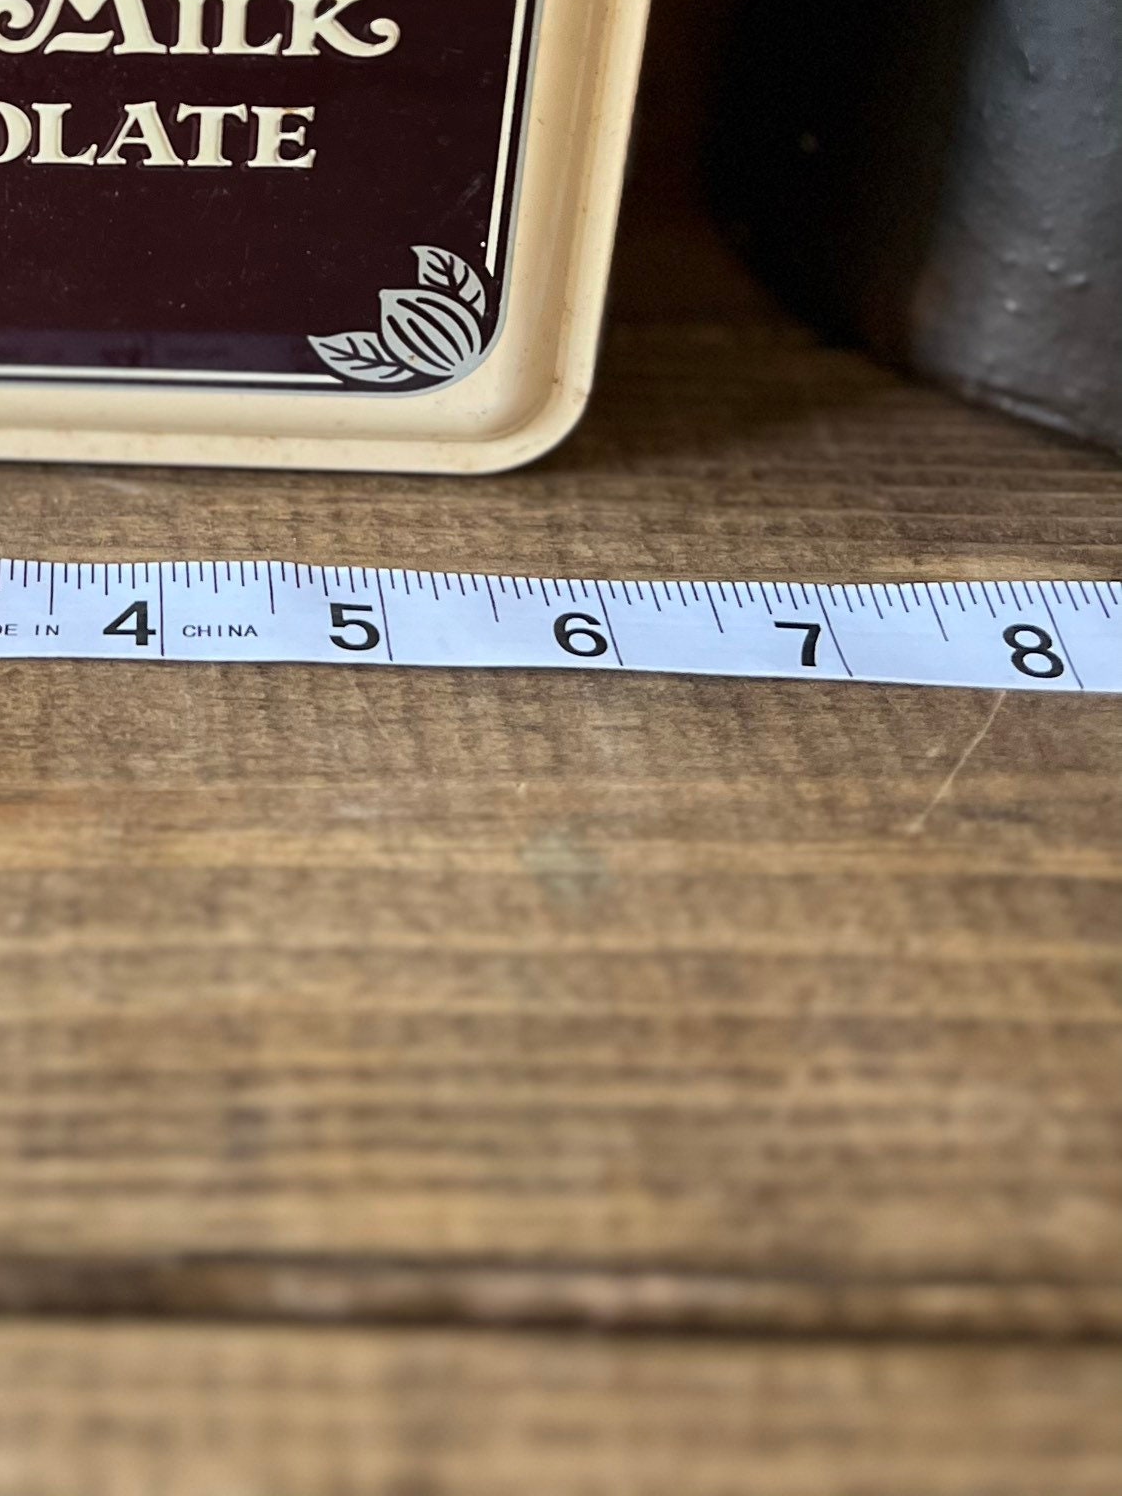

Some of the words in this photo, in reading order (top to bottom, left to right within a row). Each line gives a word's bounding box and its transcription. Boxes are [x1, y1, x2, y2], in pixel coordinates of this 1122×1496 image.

[35, 624, 60, 637] IN
[181, 624, 259, 638] CHINA
[102, 600, 157, 646] 4
[329, 602, 380, 651] 5
[553, 612, 608, 658] 6
[773, 621, 822, 667] 7
[1002, 624, 1065, 679] 8
